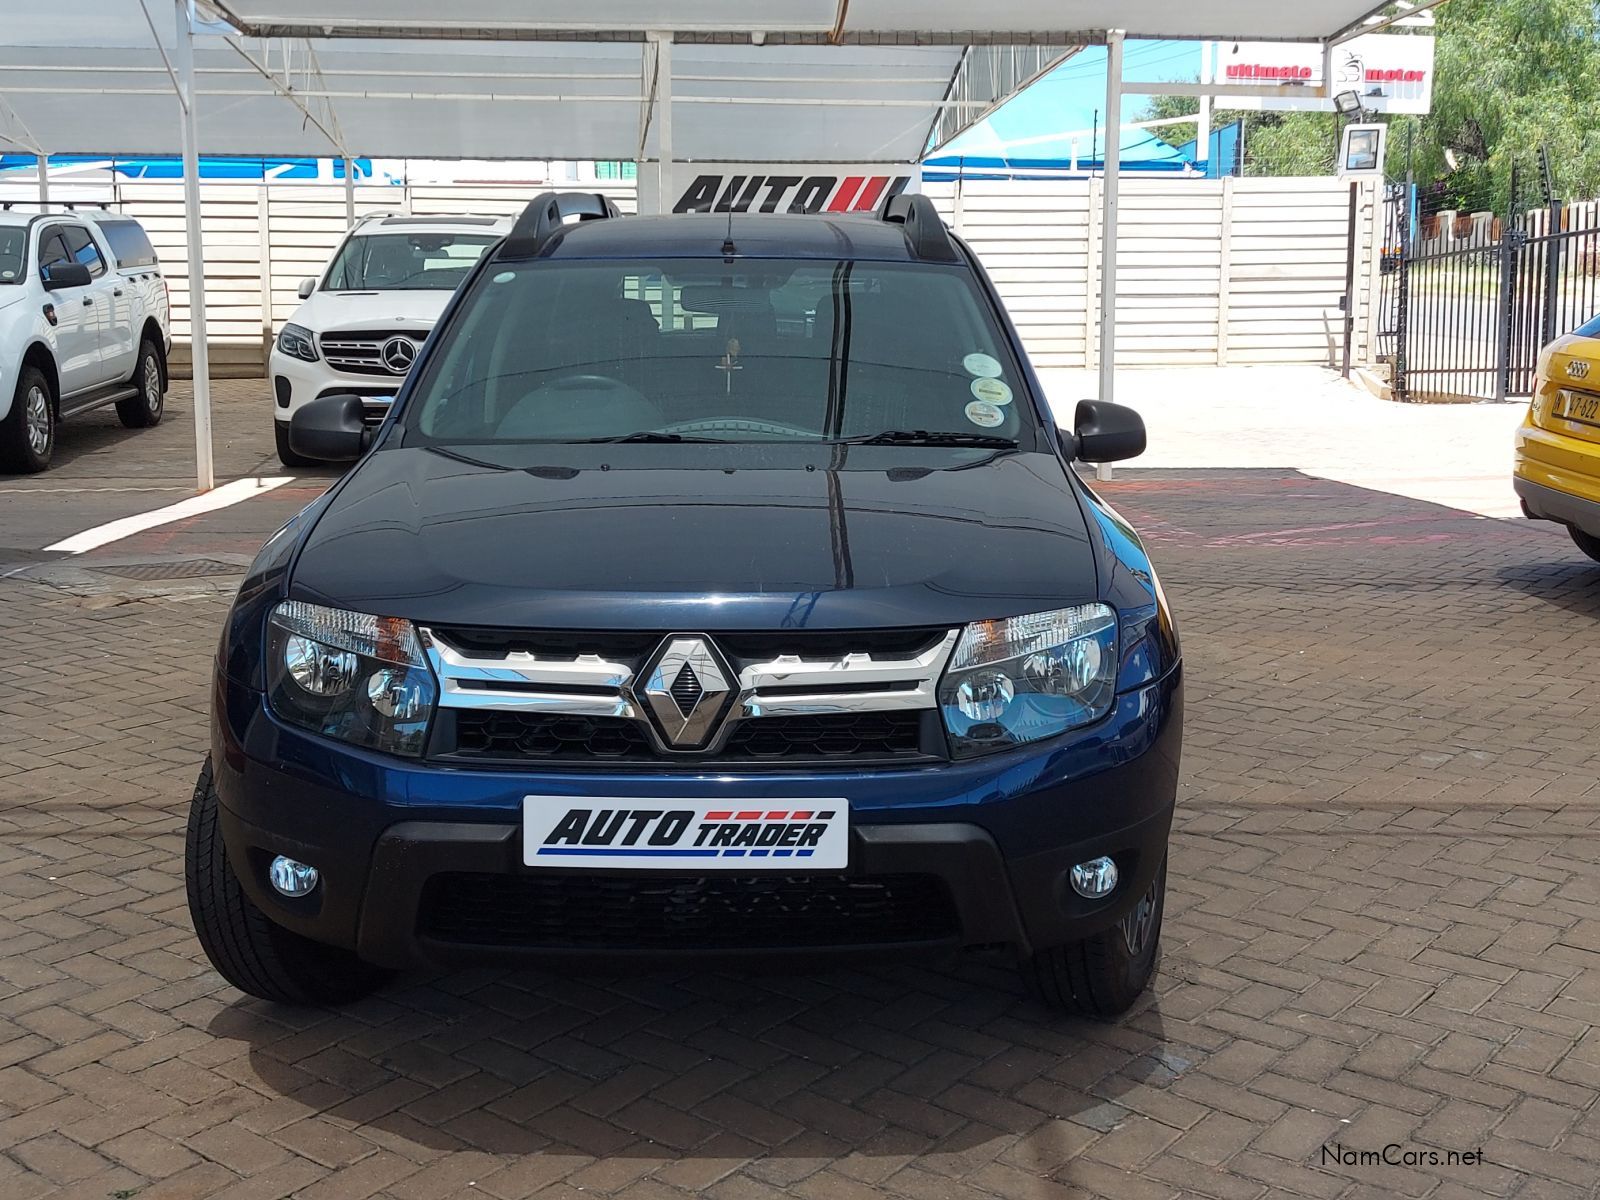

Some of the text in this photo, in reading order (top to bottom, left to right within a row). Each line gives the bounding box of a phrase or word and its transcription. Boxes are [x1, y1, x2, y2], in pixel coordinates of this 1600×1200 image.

[1226, 64, 1426, 82] ultimate motor
[672, 174, 838, 213] AUTO
[543, 809, 829, 847] AUTO TRADER
